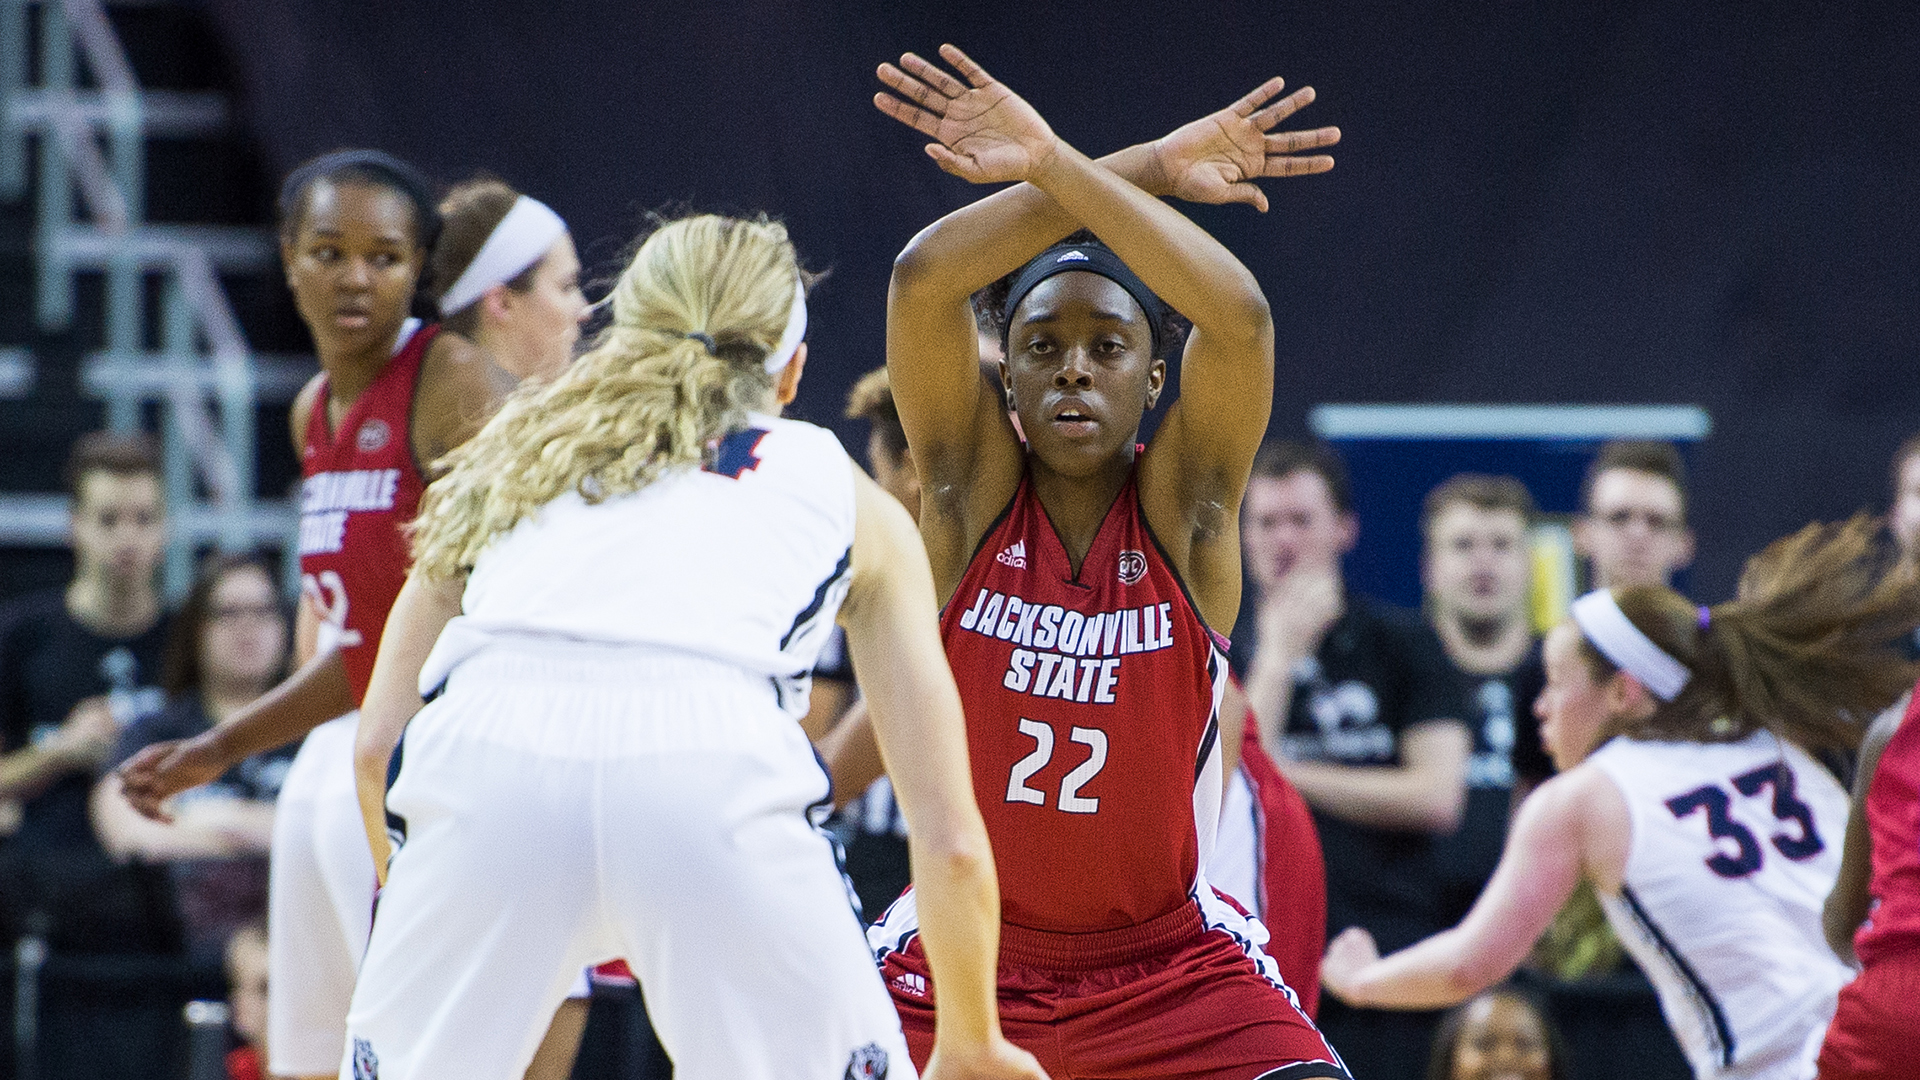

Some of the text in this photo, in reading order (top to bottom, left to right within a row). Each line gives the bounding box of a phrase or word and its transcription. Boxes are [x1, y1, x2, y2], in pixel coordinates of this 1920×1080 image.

[959, 587, 1174, 657] JACKSONVILLE
[1003, 647, 1121, 705] STATE
[1006, 716, 1110, 814] 22
[1664, 760, 1825, 878] 33
